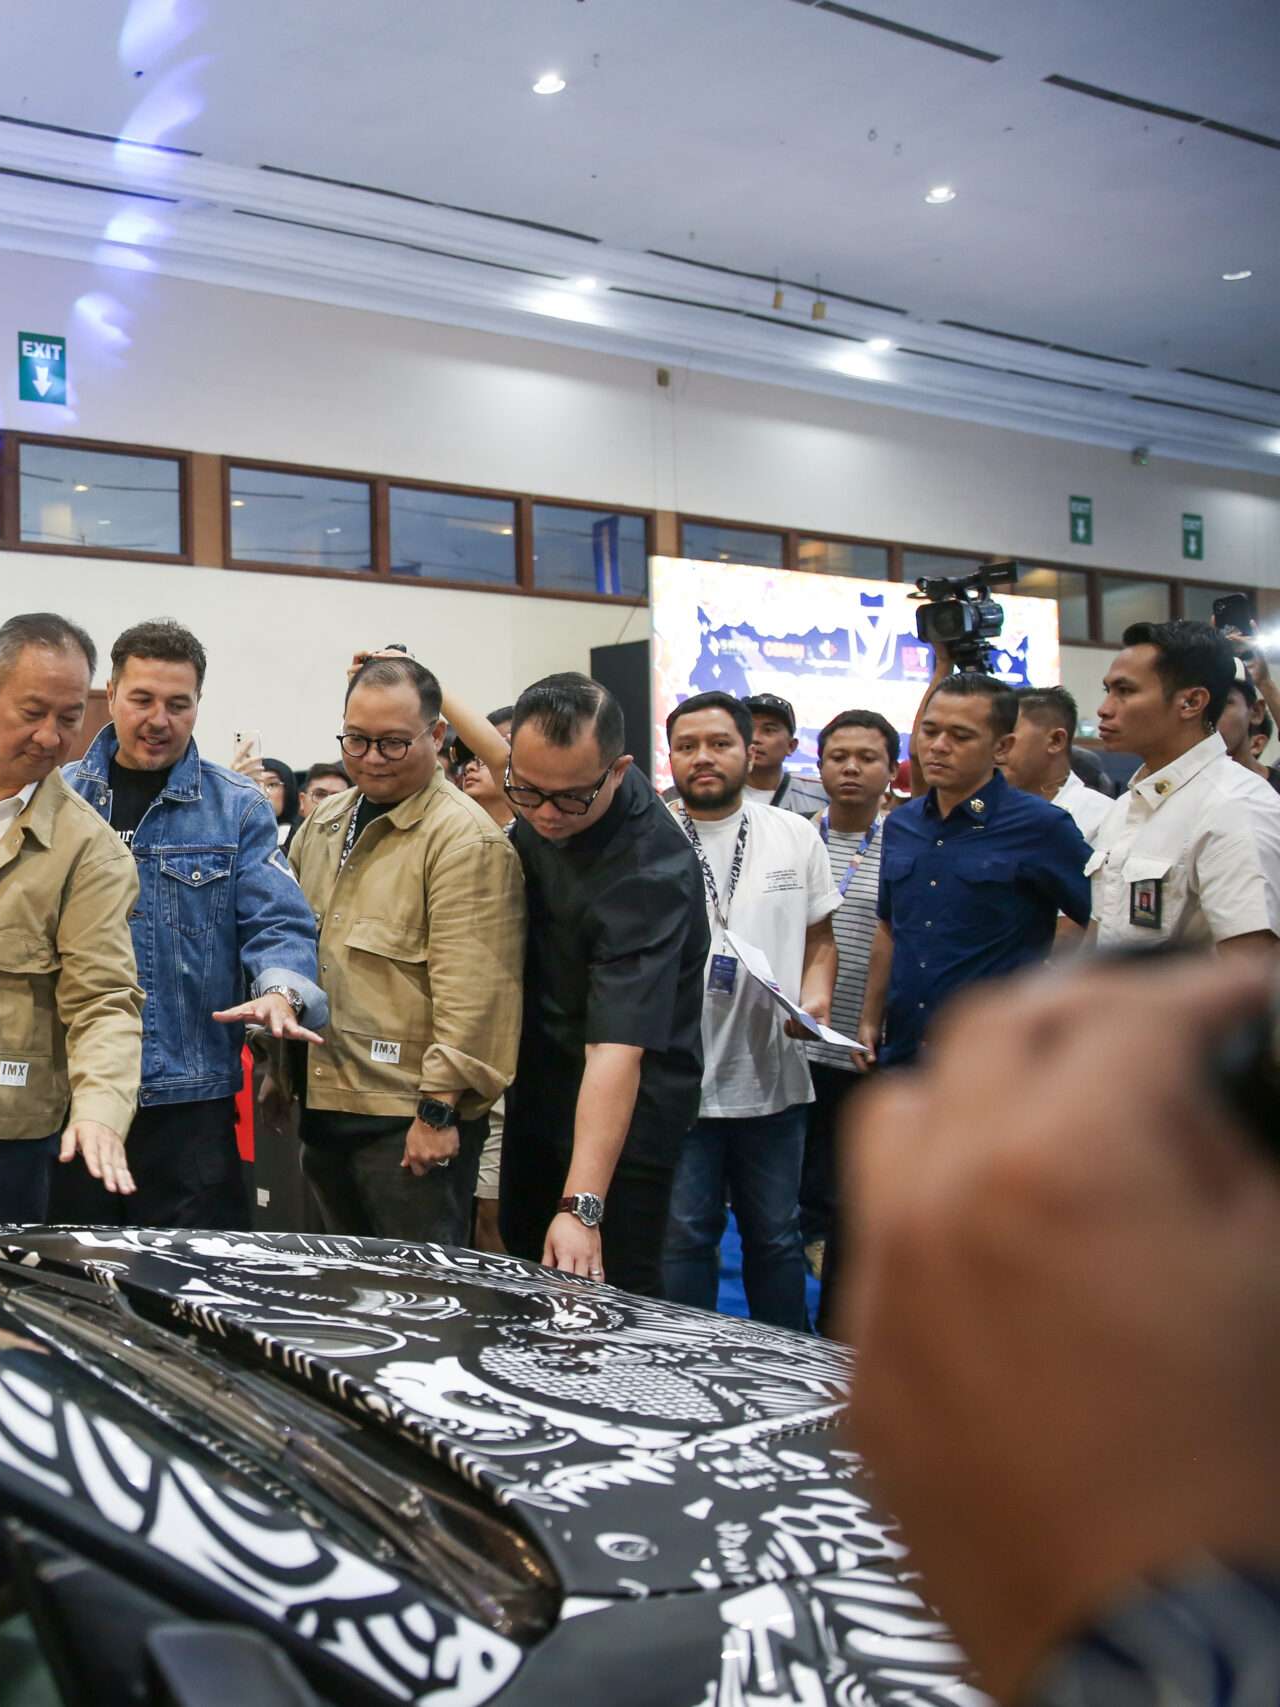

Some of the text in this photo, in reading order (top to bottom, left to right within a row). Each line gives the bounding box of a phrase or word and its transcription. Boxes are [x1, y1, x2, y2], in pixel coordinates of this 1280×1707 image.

[22, 340, 62, 361] EXIT
[373, 1042, 398, 1055] IMX
[2, 1063, 26, 1077] IMX
